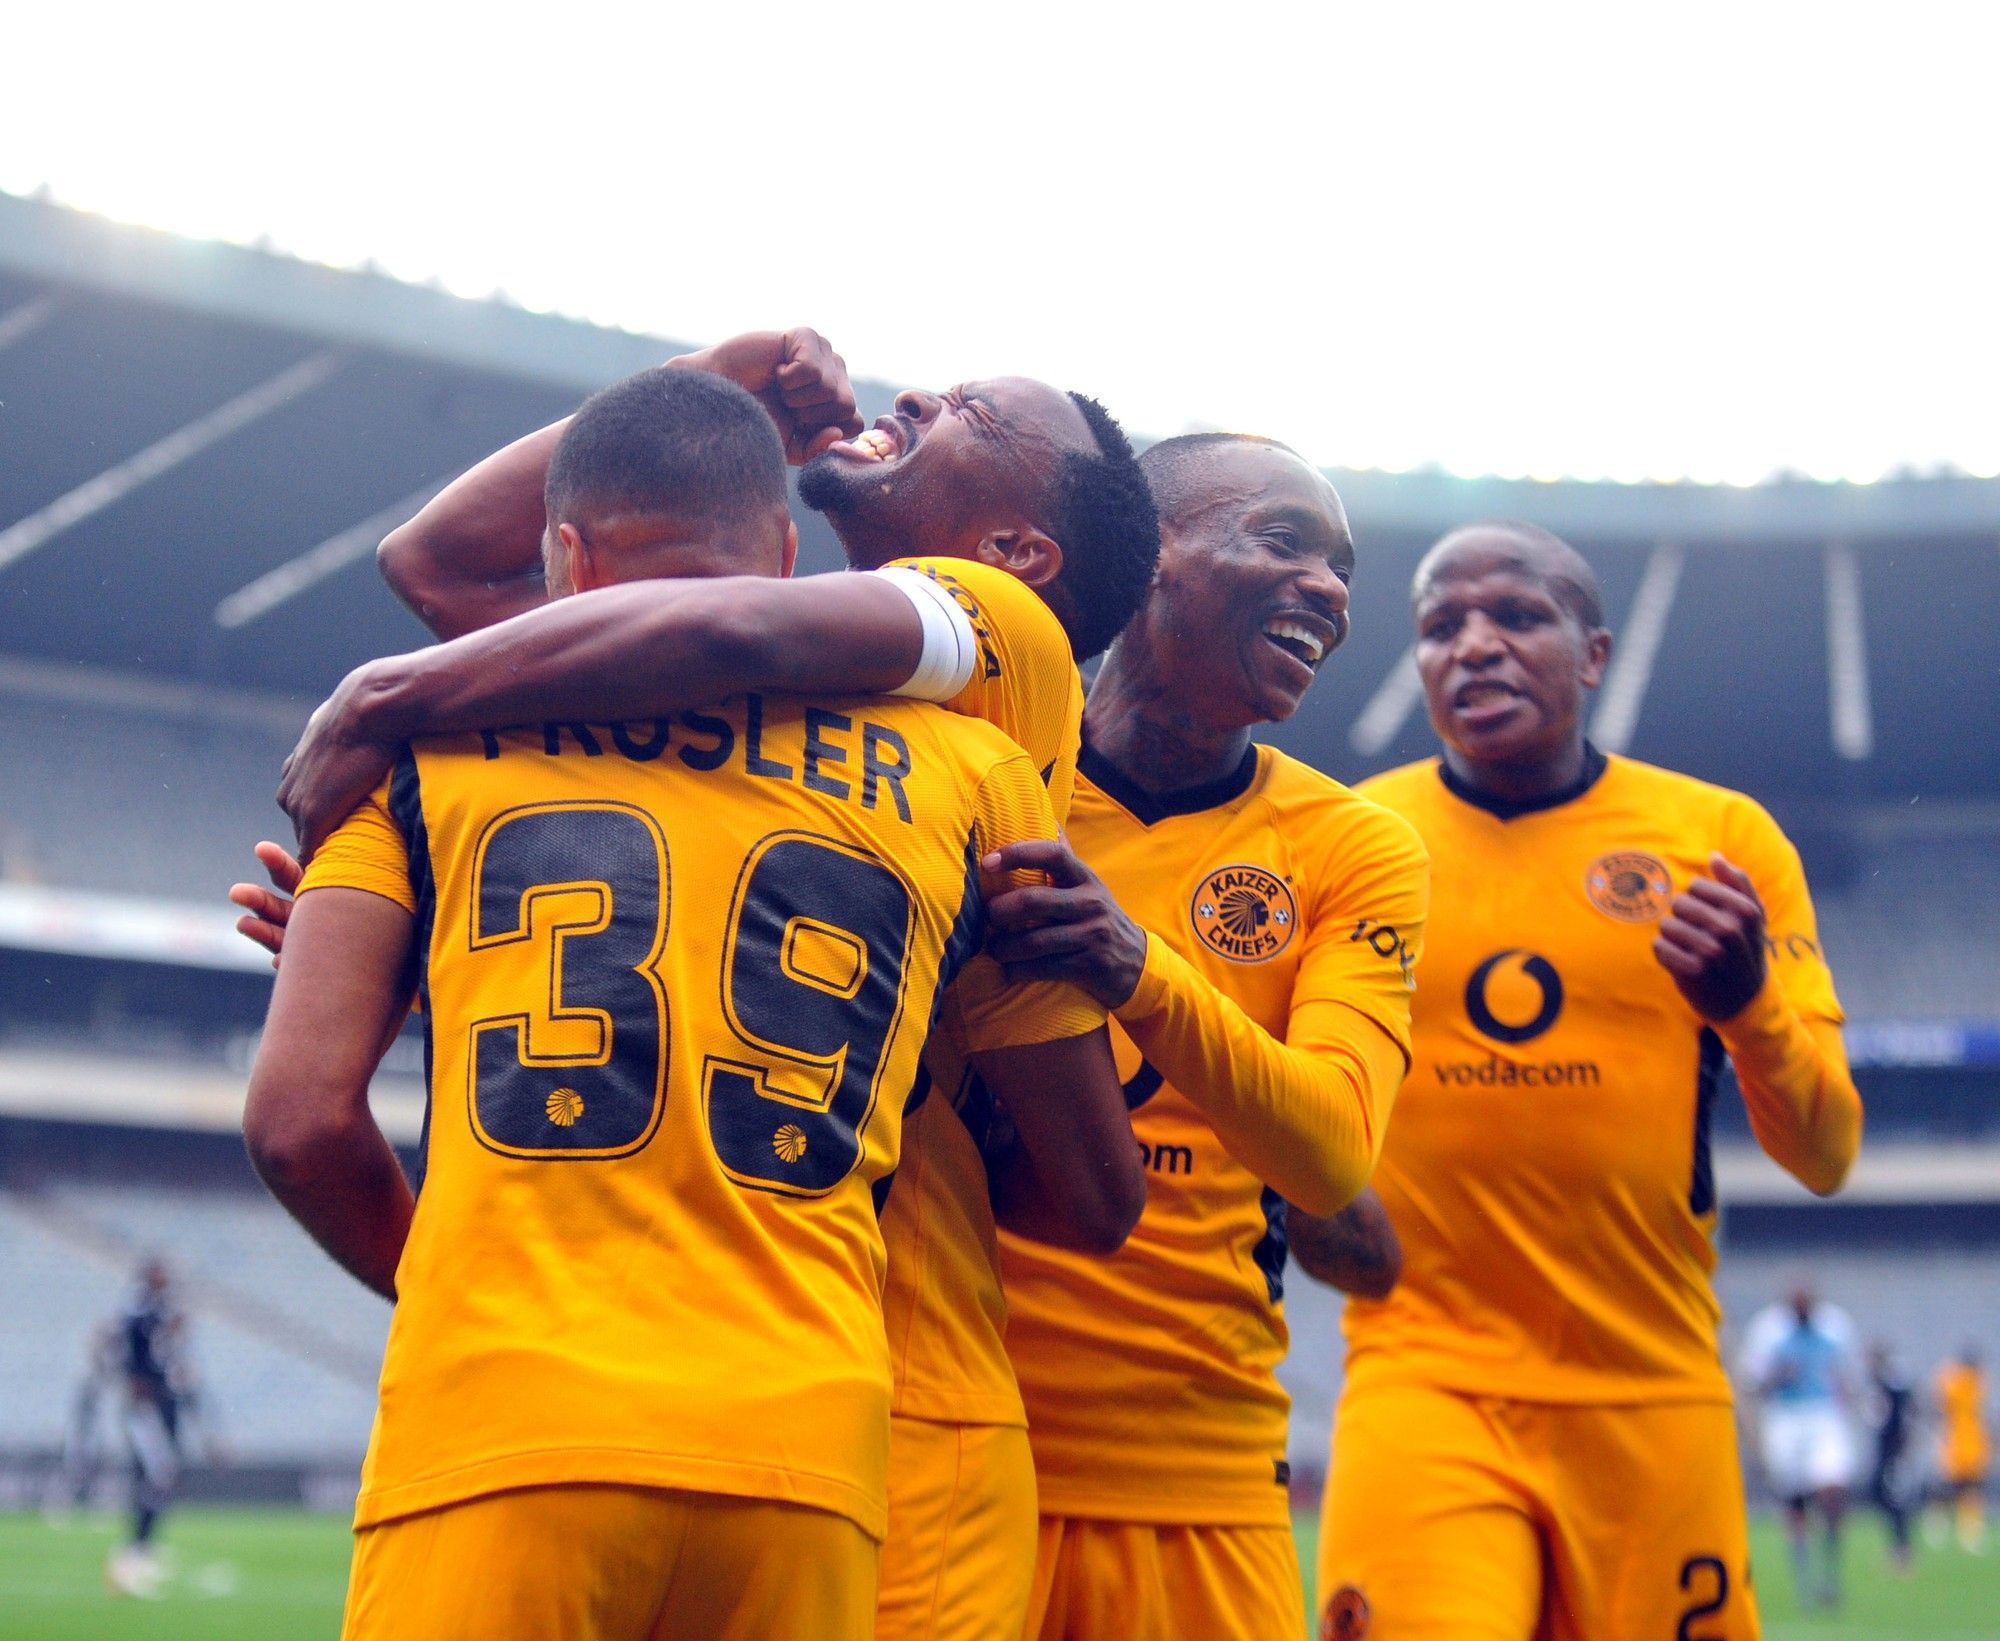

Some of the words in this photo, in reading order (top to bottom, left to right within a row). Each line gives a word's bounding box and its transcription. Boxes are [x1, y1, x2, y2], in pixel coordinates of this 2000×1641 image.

[1209, 871, 1279, 903] KAIZER
[1207, 924, 1279, 957] CHIEFS
[468, 799, 918, 1198] 39
[1433, 1055, 1600, 1087] vodacom
